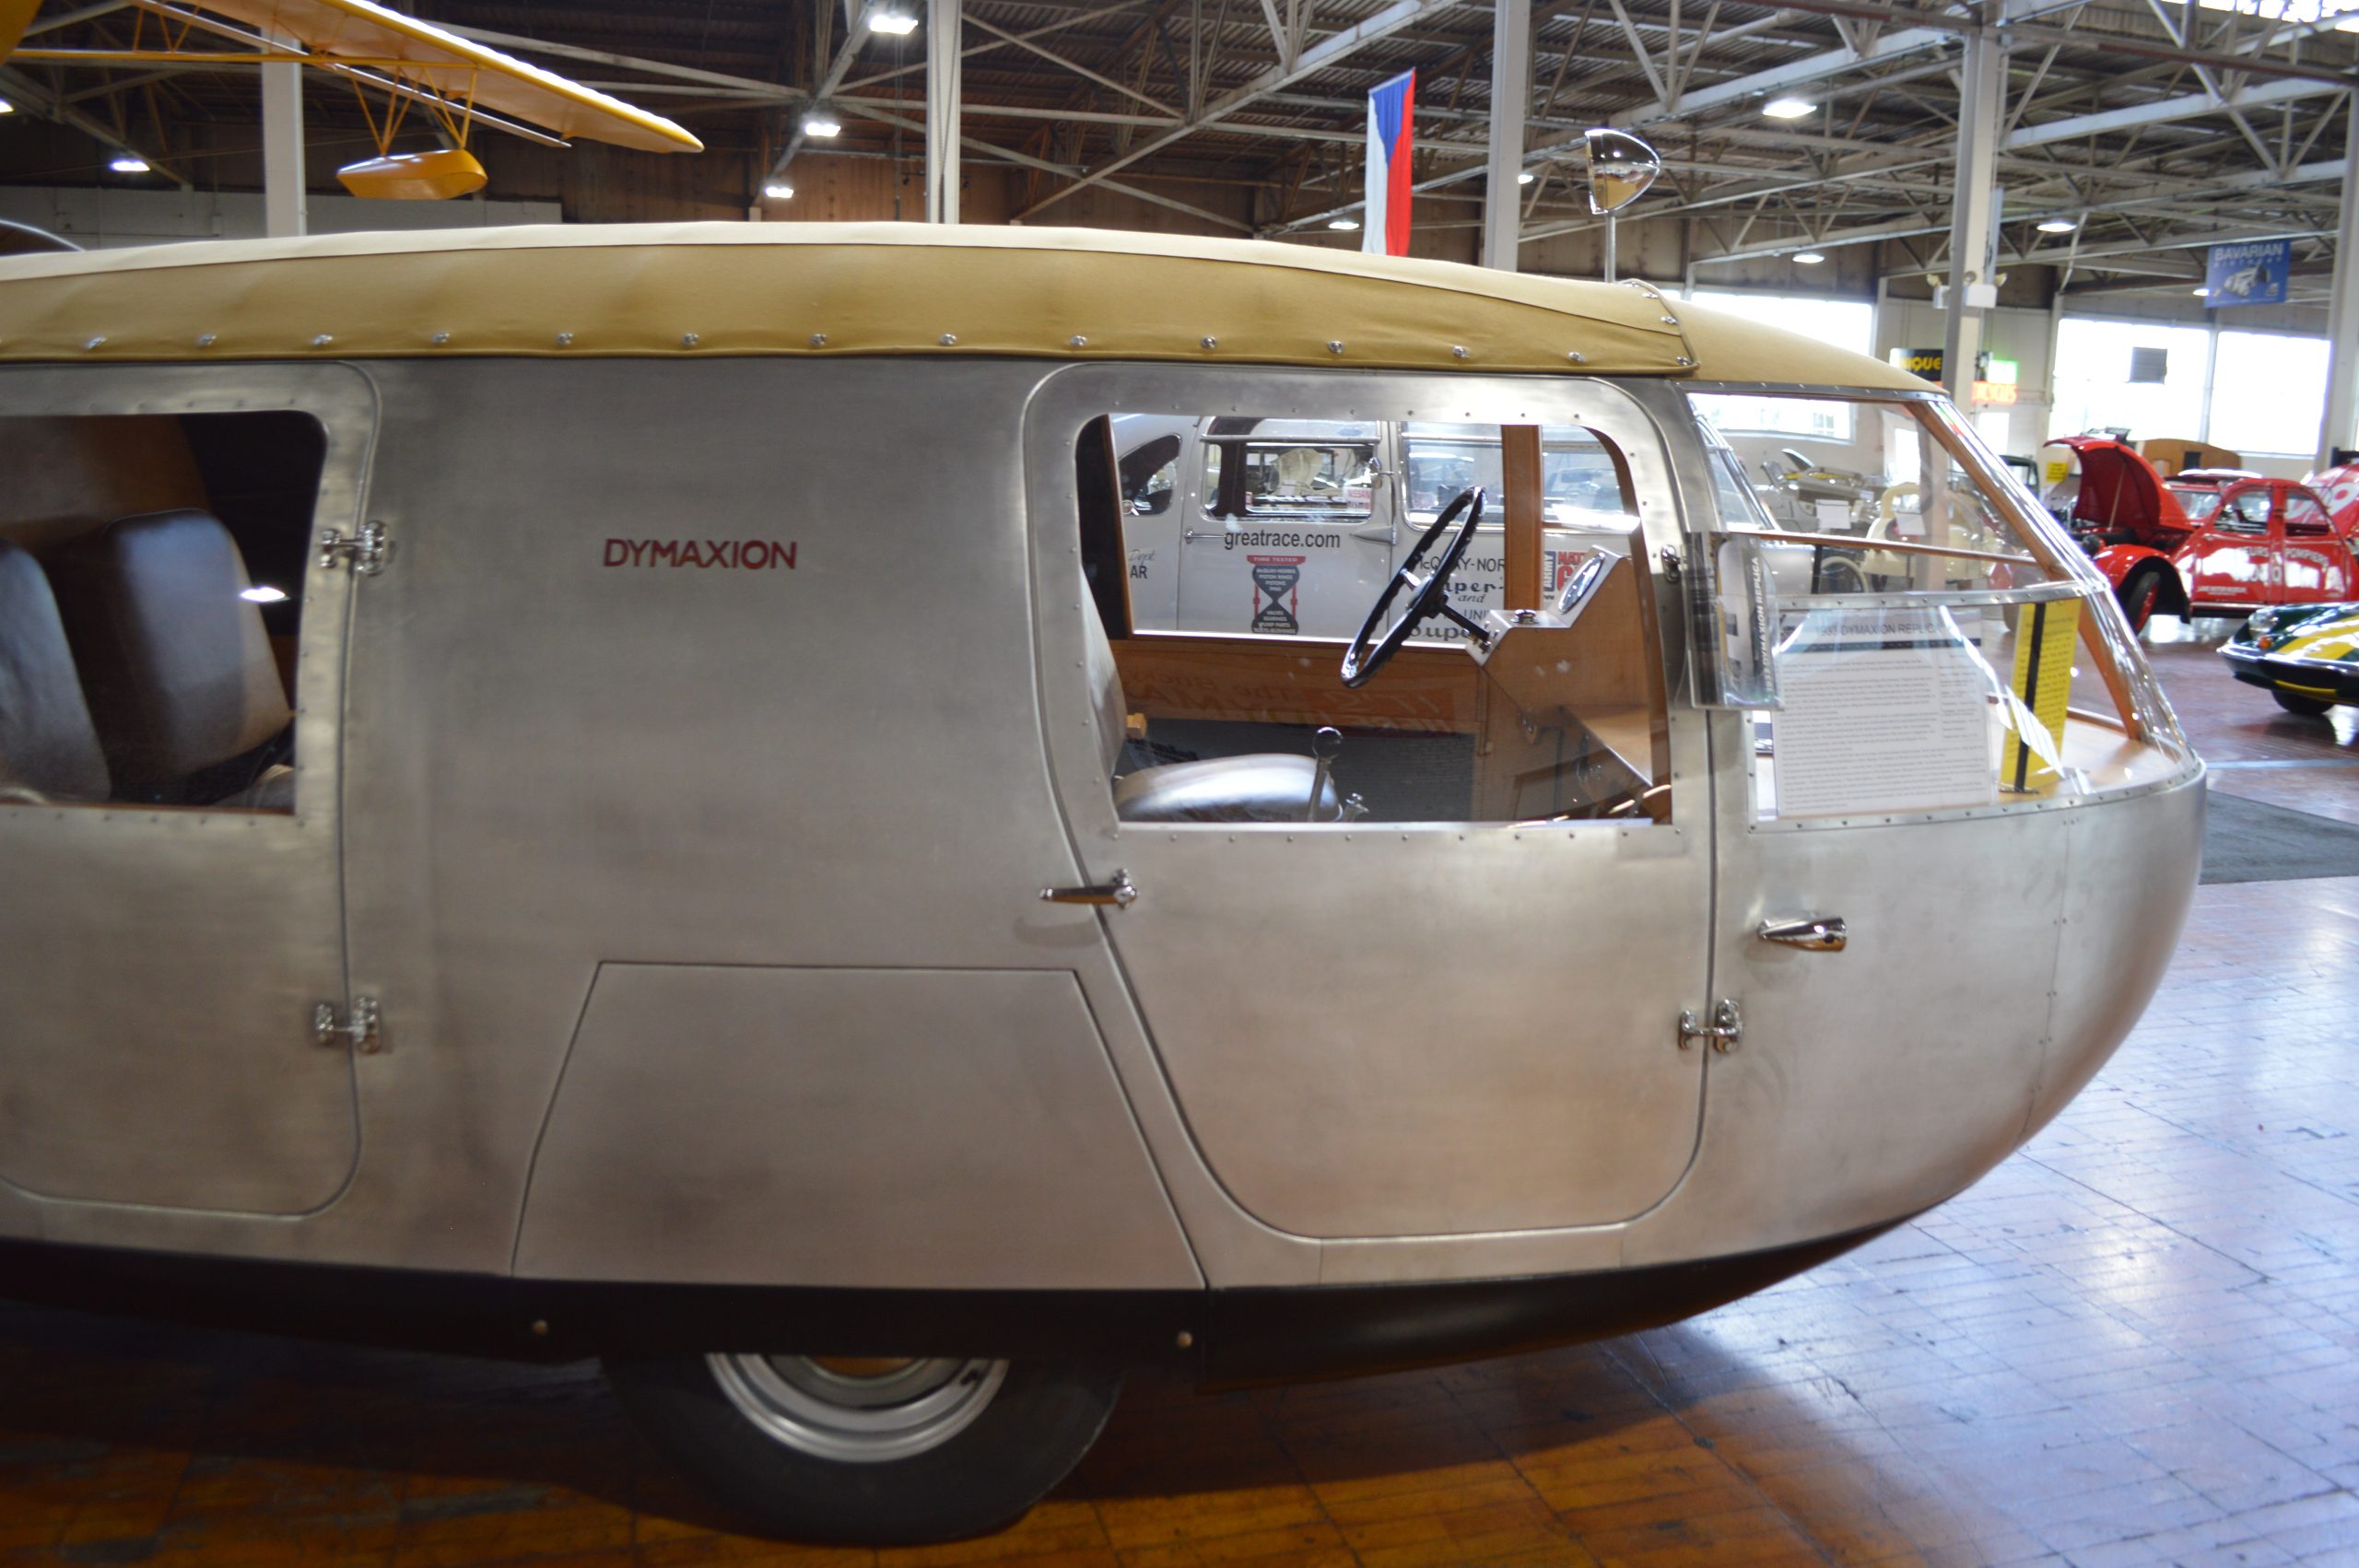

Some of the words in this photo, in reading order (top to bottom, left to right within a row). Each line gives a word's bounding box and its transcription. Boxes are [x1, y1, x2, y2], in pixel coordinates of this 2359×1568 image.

[2214, 242, 2283, 262] BAVARIAN
[1224, 530, 1341, 550] greatrace.com
[603, 538, 798, 570] DYMAXION
[1130, 565, 1147, 579] AR
[1543, 555, 1555, 588] ARMY
[1751, 556, 1763, 603] REPLICA
[1458, 592, 1486, 603] and
[1755, 604, 1769, 667] DYMAXION
